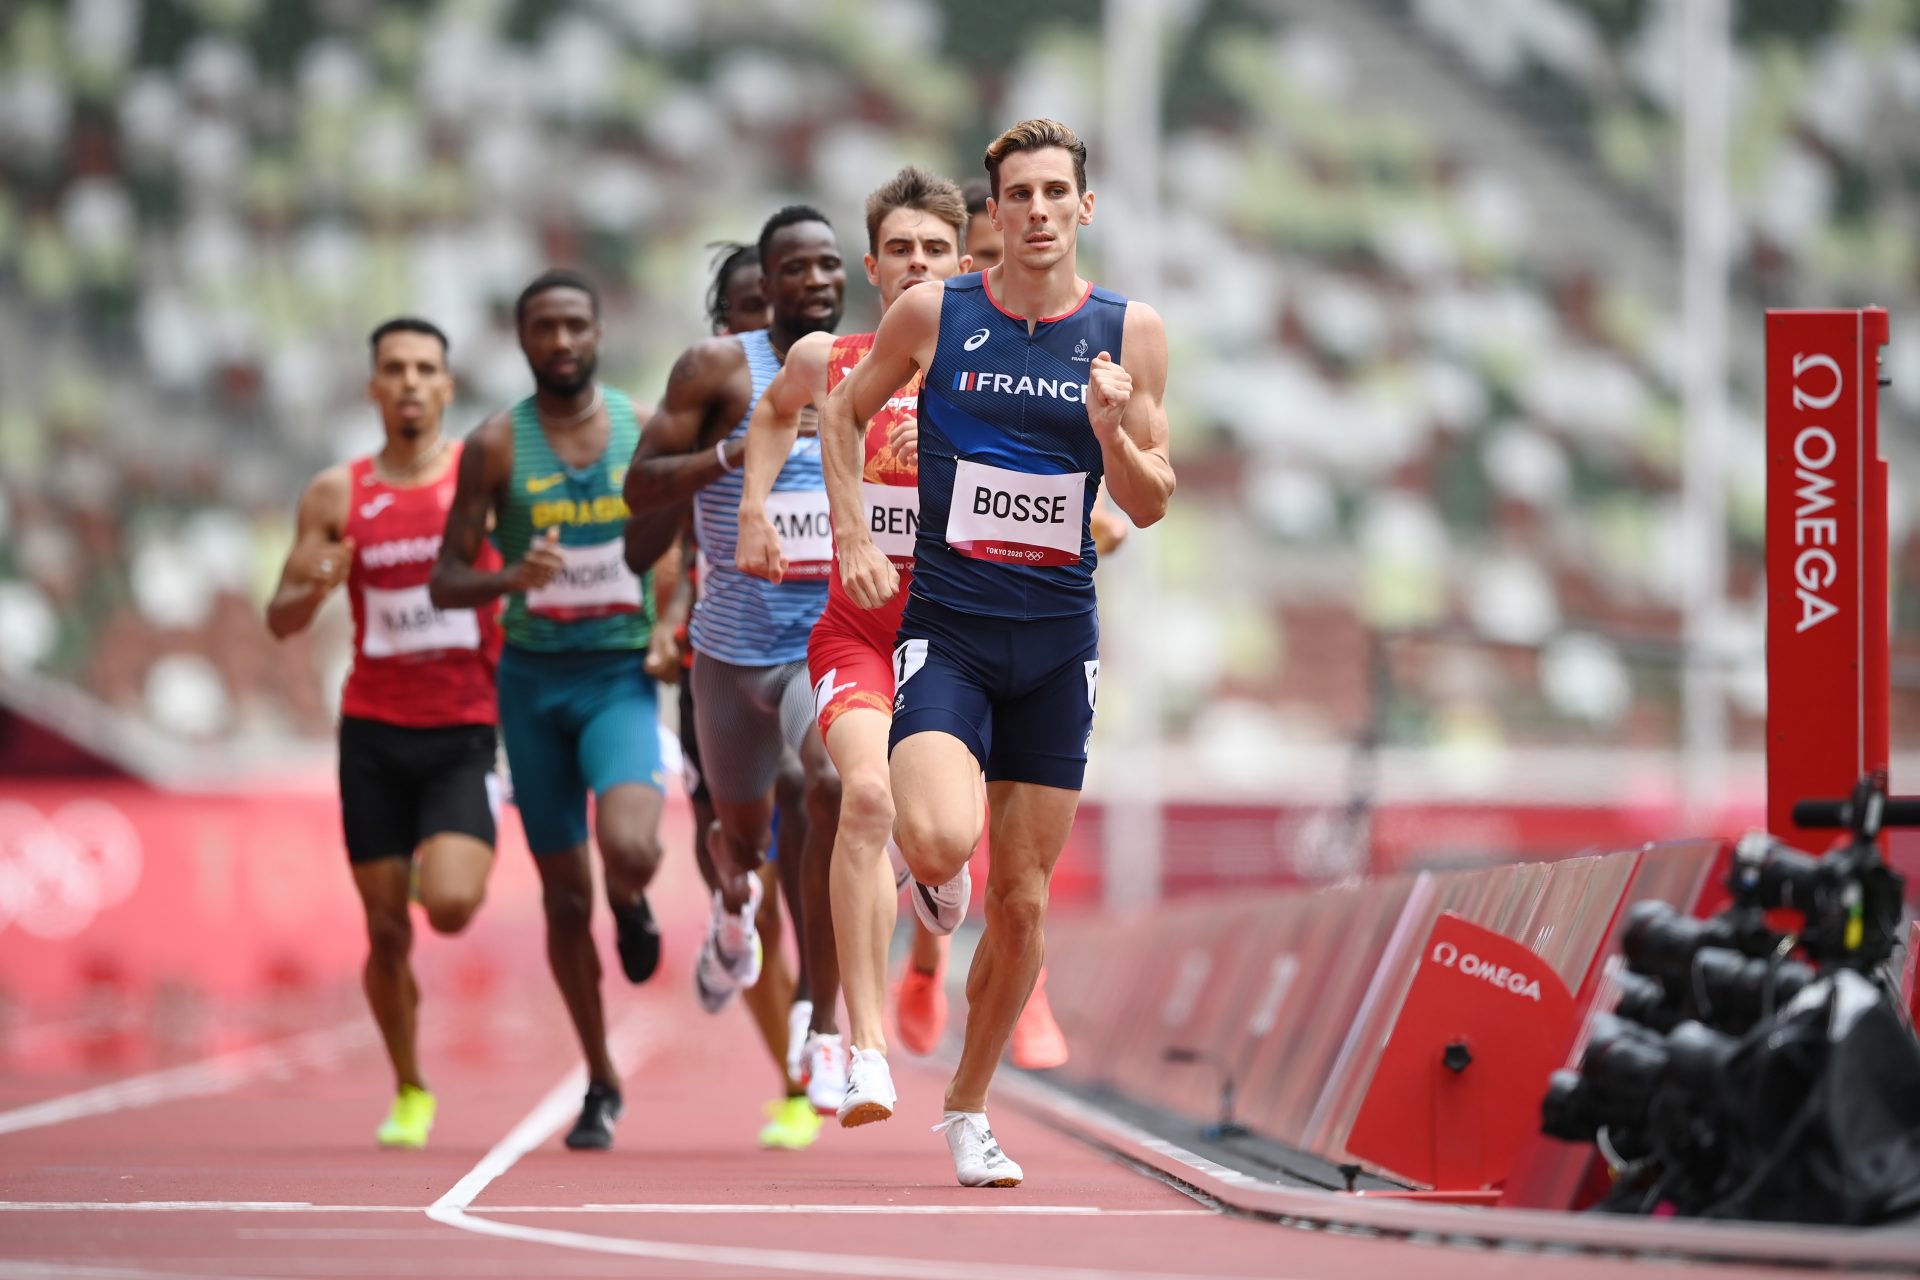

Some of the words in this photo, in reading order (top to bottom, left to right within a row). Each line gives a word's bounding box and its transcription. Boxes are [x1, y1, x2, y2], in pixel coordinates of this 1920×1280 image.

[871, 505, 920, 535] BEN
[973, 486, 1067, 524] BOSSE
[773, 512, 830, 539] AMO
[1793, 426, 1840, 633] OMEGA
[985, 546, 1007, 556] TOKYO
[1007, 549, 1024, 558] 2020
[1458, 953, 1543, 1002] OMEGA
